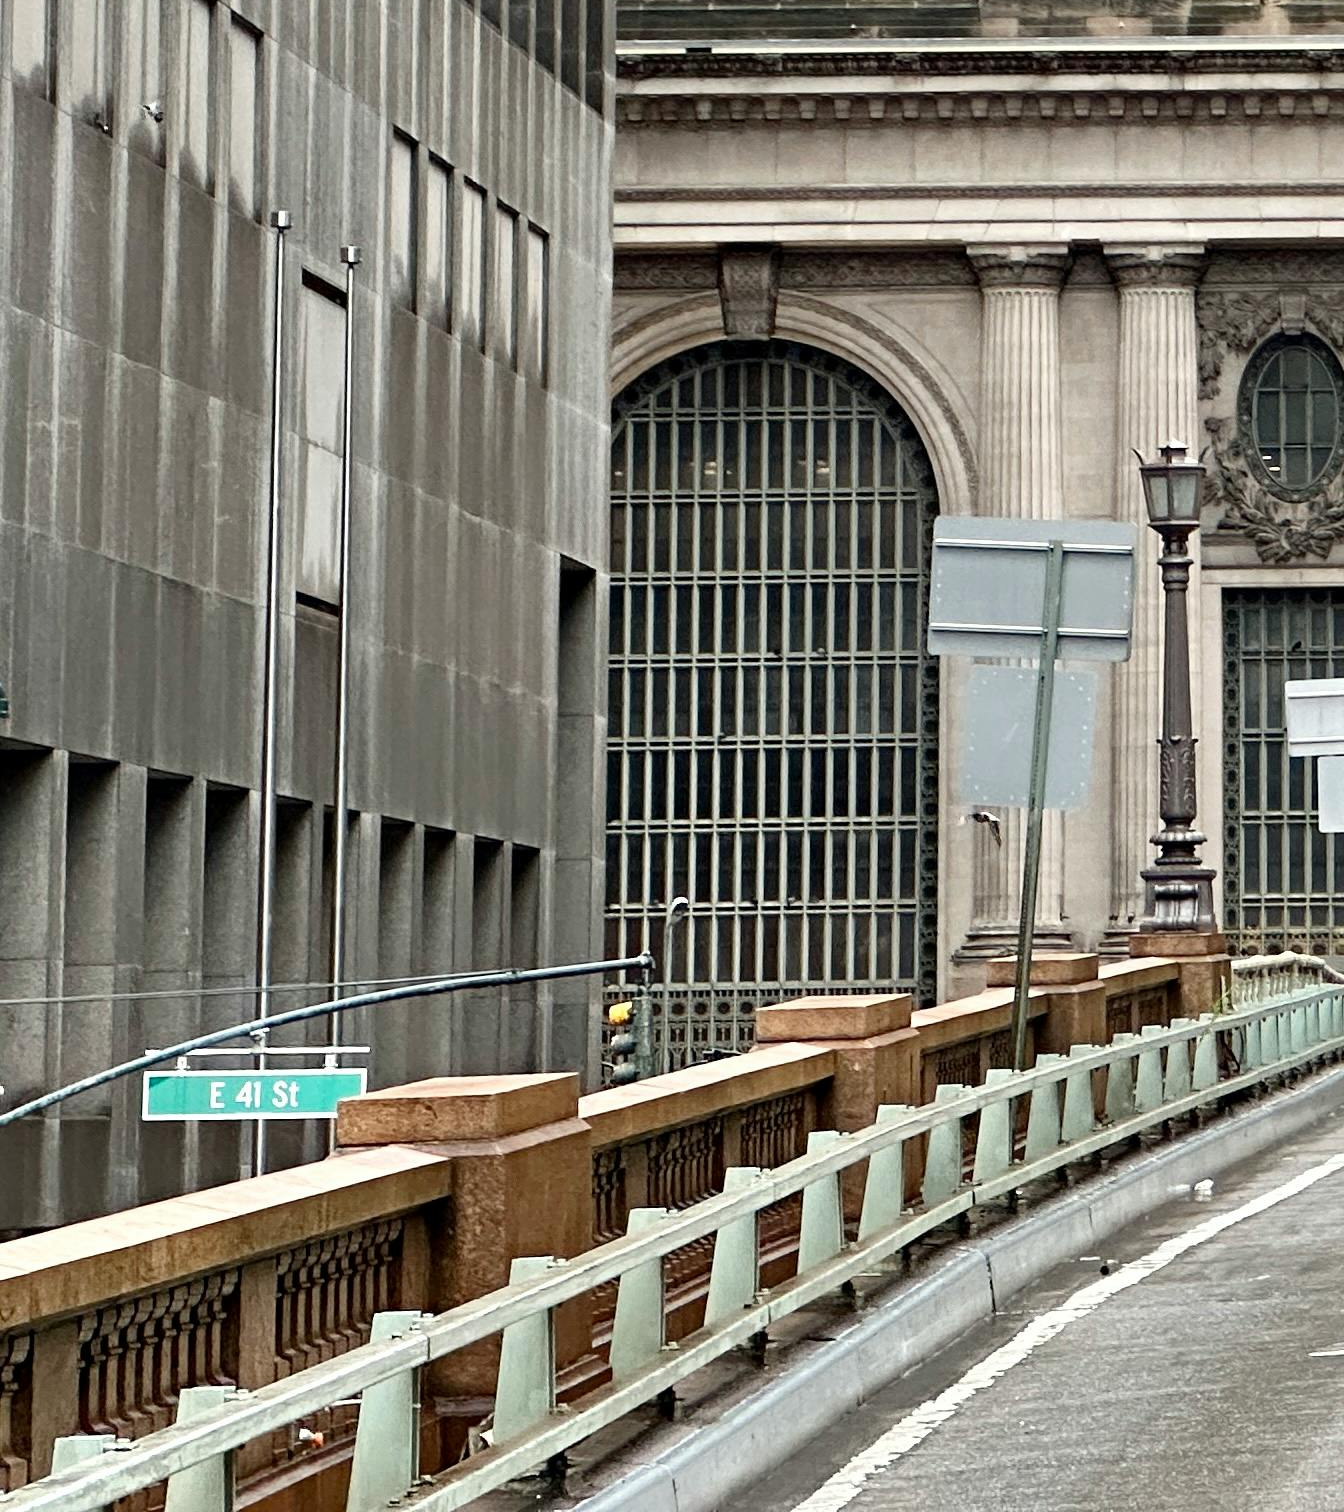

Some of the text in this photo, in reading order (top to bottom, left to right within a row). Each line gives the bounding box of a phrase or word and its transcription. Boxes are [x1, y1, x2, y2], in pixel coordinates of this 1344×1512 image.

[209, 1080, 300, 1109] E 41 St
